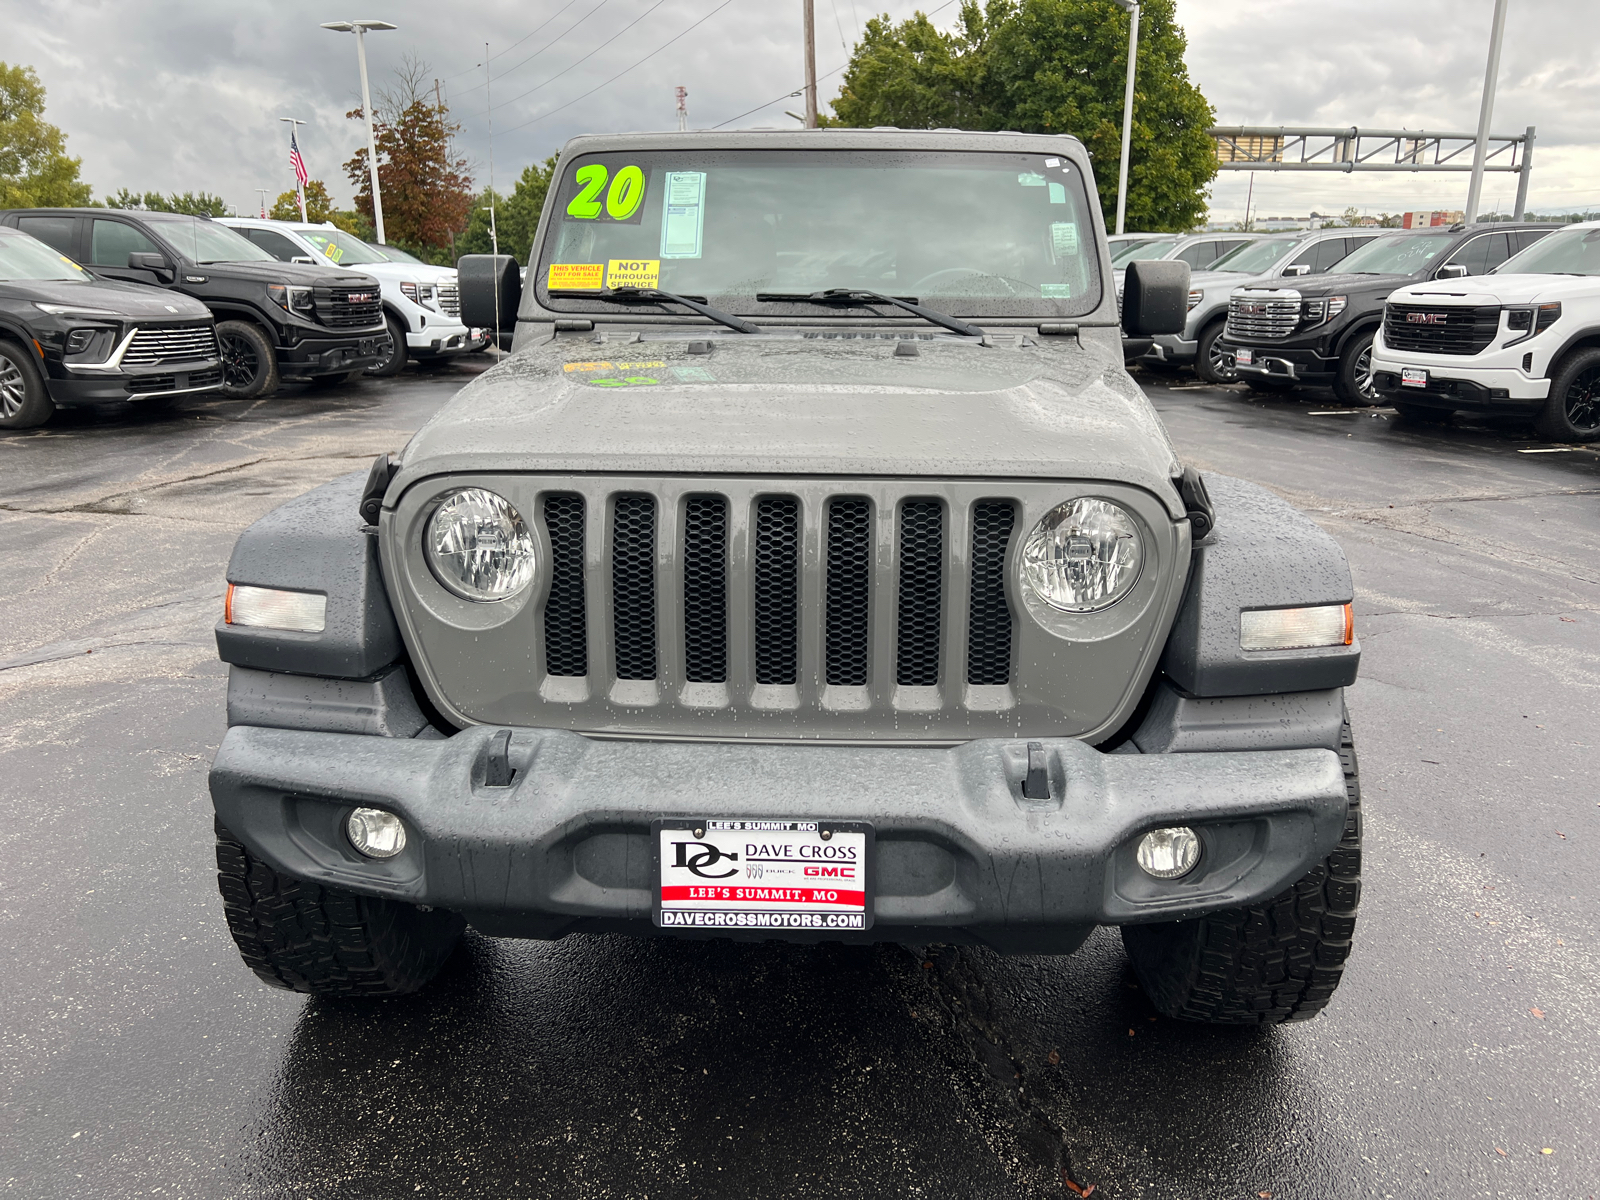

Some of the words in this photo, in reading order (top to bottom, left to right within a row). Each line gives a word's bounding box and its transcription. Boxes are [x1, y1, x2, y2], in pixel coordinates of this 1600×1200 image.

[567, 164, 645, 220] 20
[618, 262, 650, 271] NOT
[1240, 305, 1265, 315] GMC
[1406, 312, 1448, 325] GMC
[709, 821, 741, 830] LEE'S
[744, 822, 792, 831] SUMMIT
[797, 822, 816, 831] MO
[745, 844, 793, 857] DAVE
[799, 845, 857, 860] CROSS
[804, 866, 855, 878] GMC
[689, 887, 731, 898] LEE'S
[736, 888, 806, 902] SUMMIT,
[812, 891, 838, 901] MO
[663, 912, 863, 928] DAVECROSSMOTORS.COM
